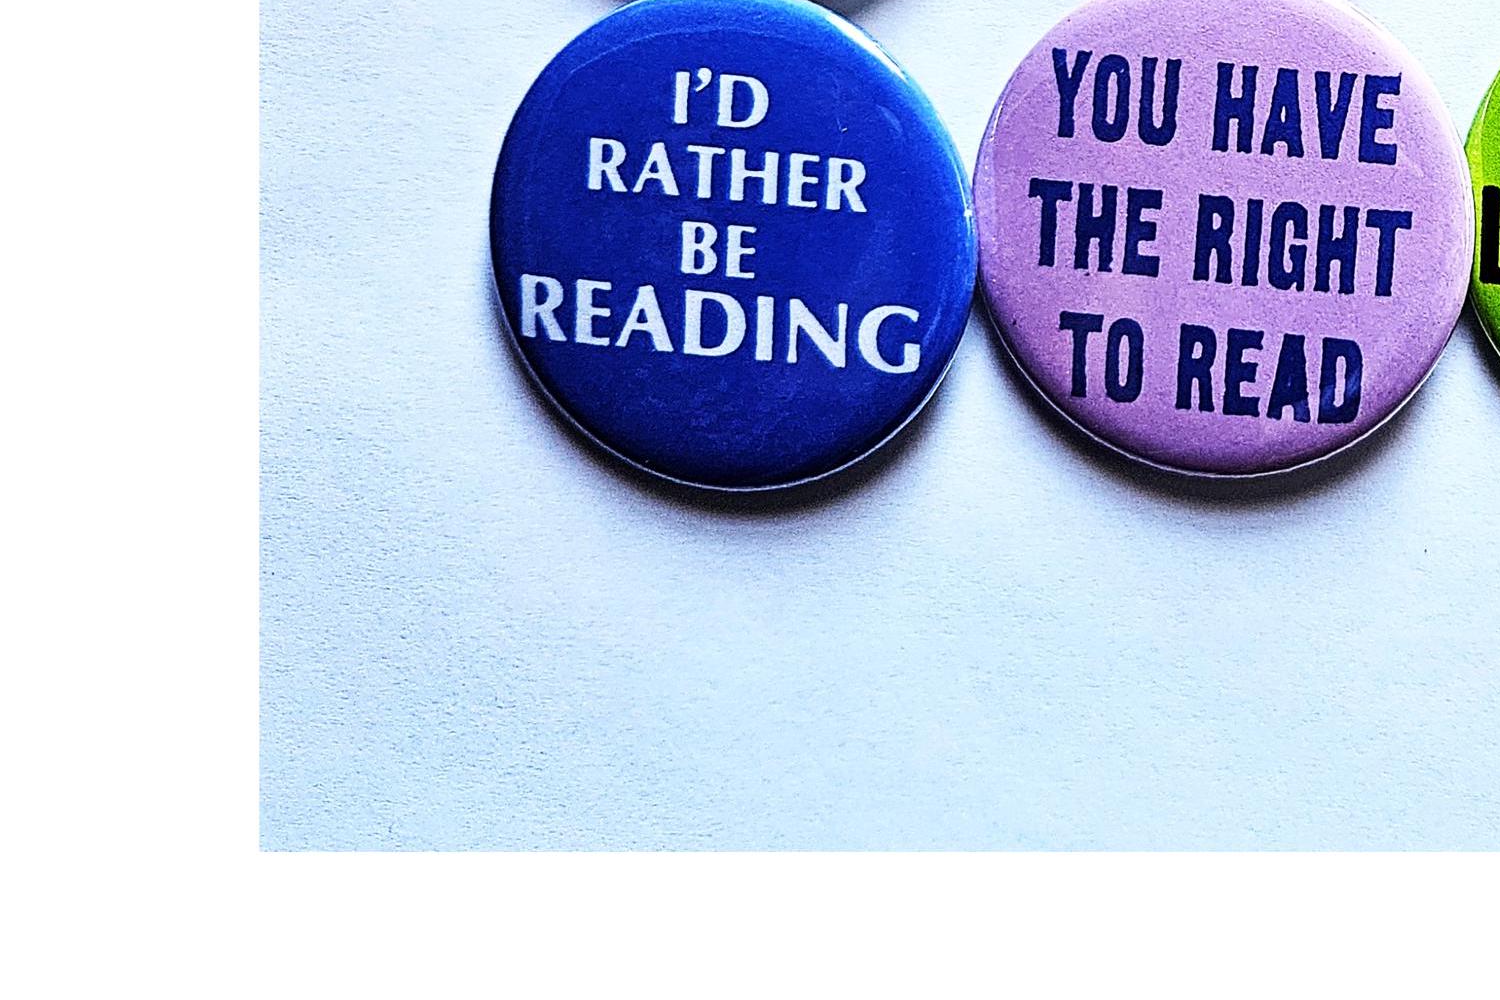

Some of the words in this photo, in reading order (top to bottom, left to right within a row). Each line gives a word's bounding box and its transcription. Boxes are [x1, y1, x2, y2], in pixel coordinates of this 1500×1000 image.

[673, 67, 769, 129] I'D
[1052, 47, 1182, 146] YOU
[1212, 62, 1401, 165] HAVE
[587, 137, 867, 213] RATHER
[680, 221, 757, 279] BE
[1028, 178, 1163, 277] THE
[1193, 194, 1412, 297] RIGHT
[519, 274, 920, 373] READING
[1059, 311, 1143, 402] TO
[1175, 323, 1362, 424] READ
